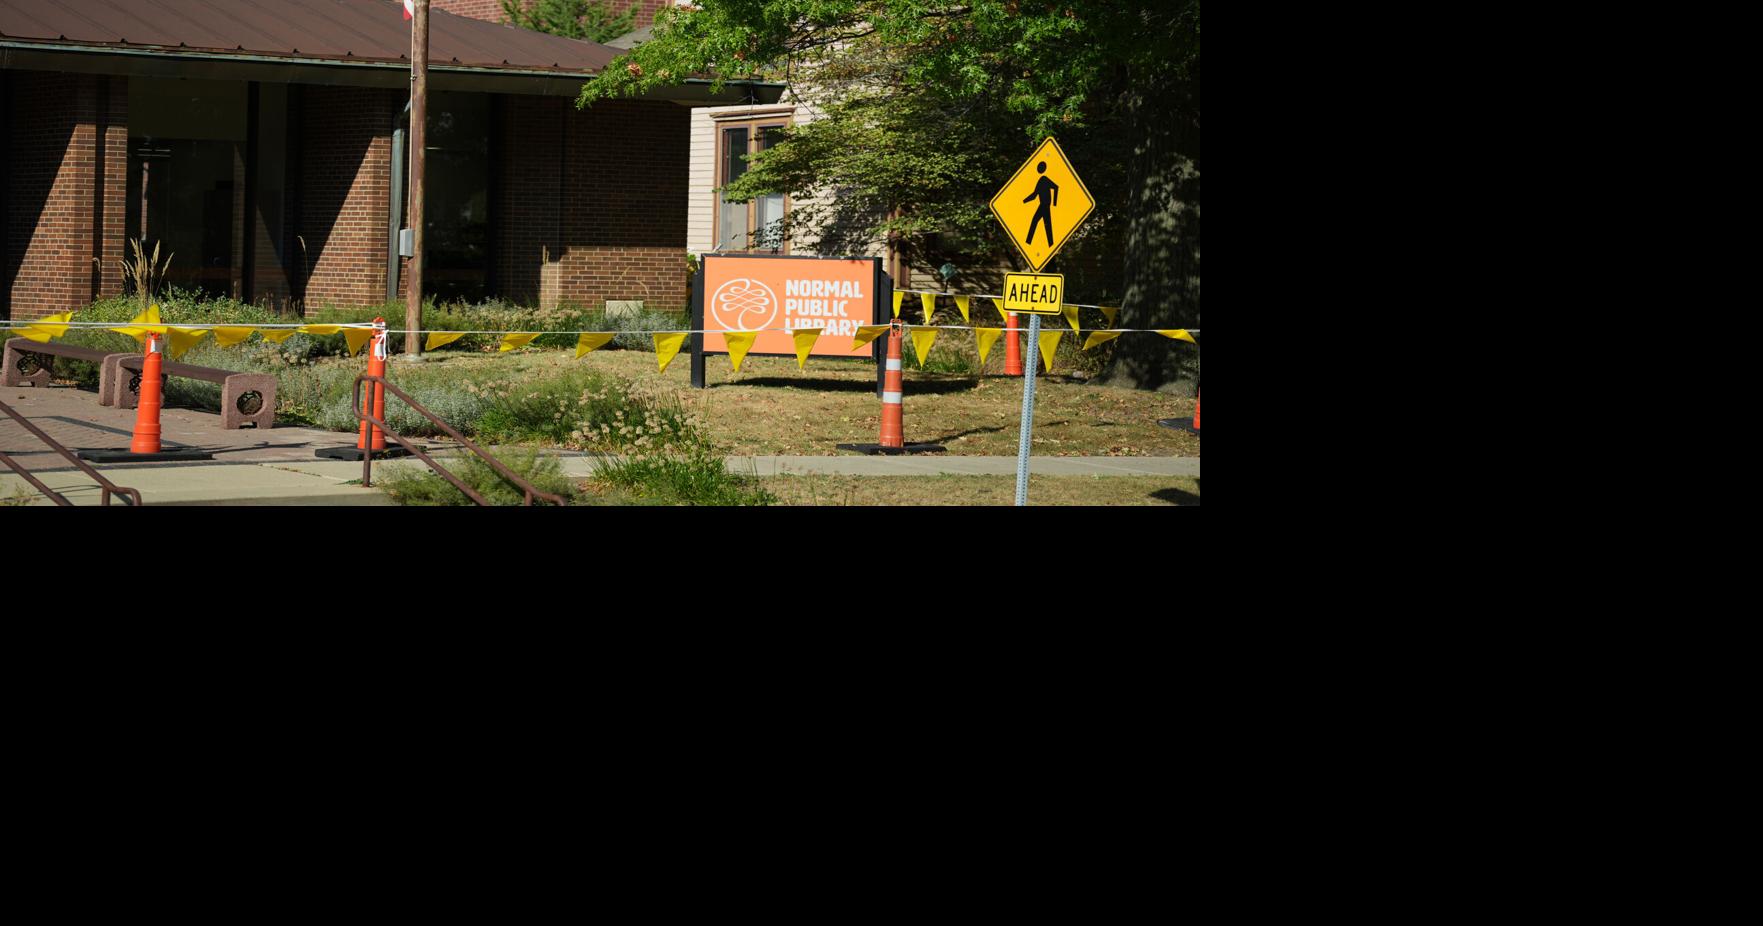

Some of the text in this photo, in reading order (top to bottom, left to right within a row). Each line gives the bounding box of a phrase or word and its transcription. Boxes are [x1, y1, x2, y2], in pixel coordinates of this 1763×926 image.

[785, 279, 863, 298] NORMAL
[1009, 283, 1058, 304] AHEAD
[785, 299, 848, 317] PUBLIC
